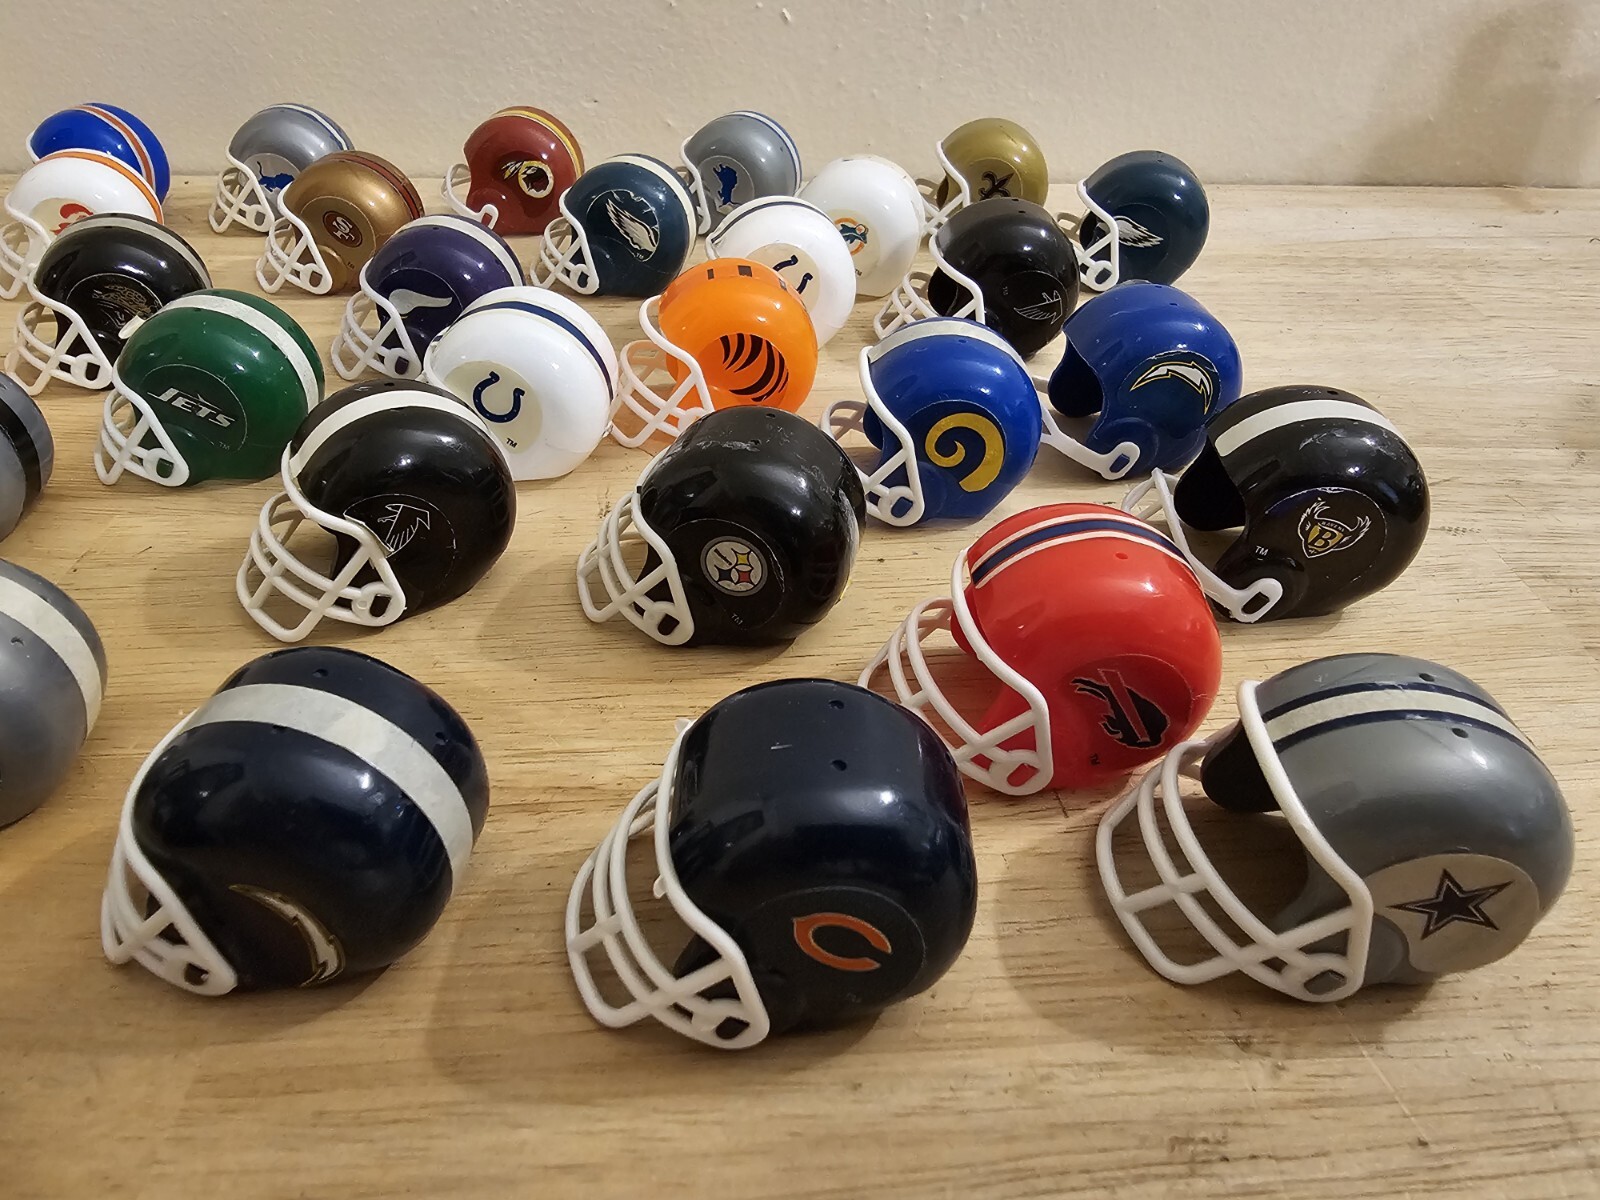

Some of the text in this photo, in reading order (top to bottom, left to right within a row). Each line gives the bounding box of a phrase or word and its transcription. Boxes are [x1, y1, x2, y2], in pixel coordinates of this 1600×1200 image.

[147, 387, 235, 428] JETS
[506, 437, 518, 449] TM
[1309, 527, 1338, 549] B
[1254, 545, 1269, 556] TM
[793, 911, 893, 972] C
